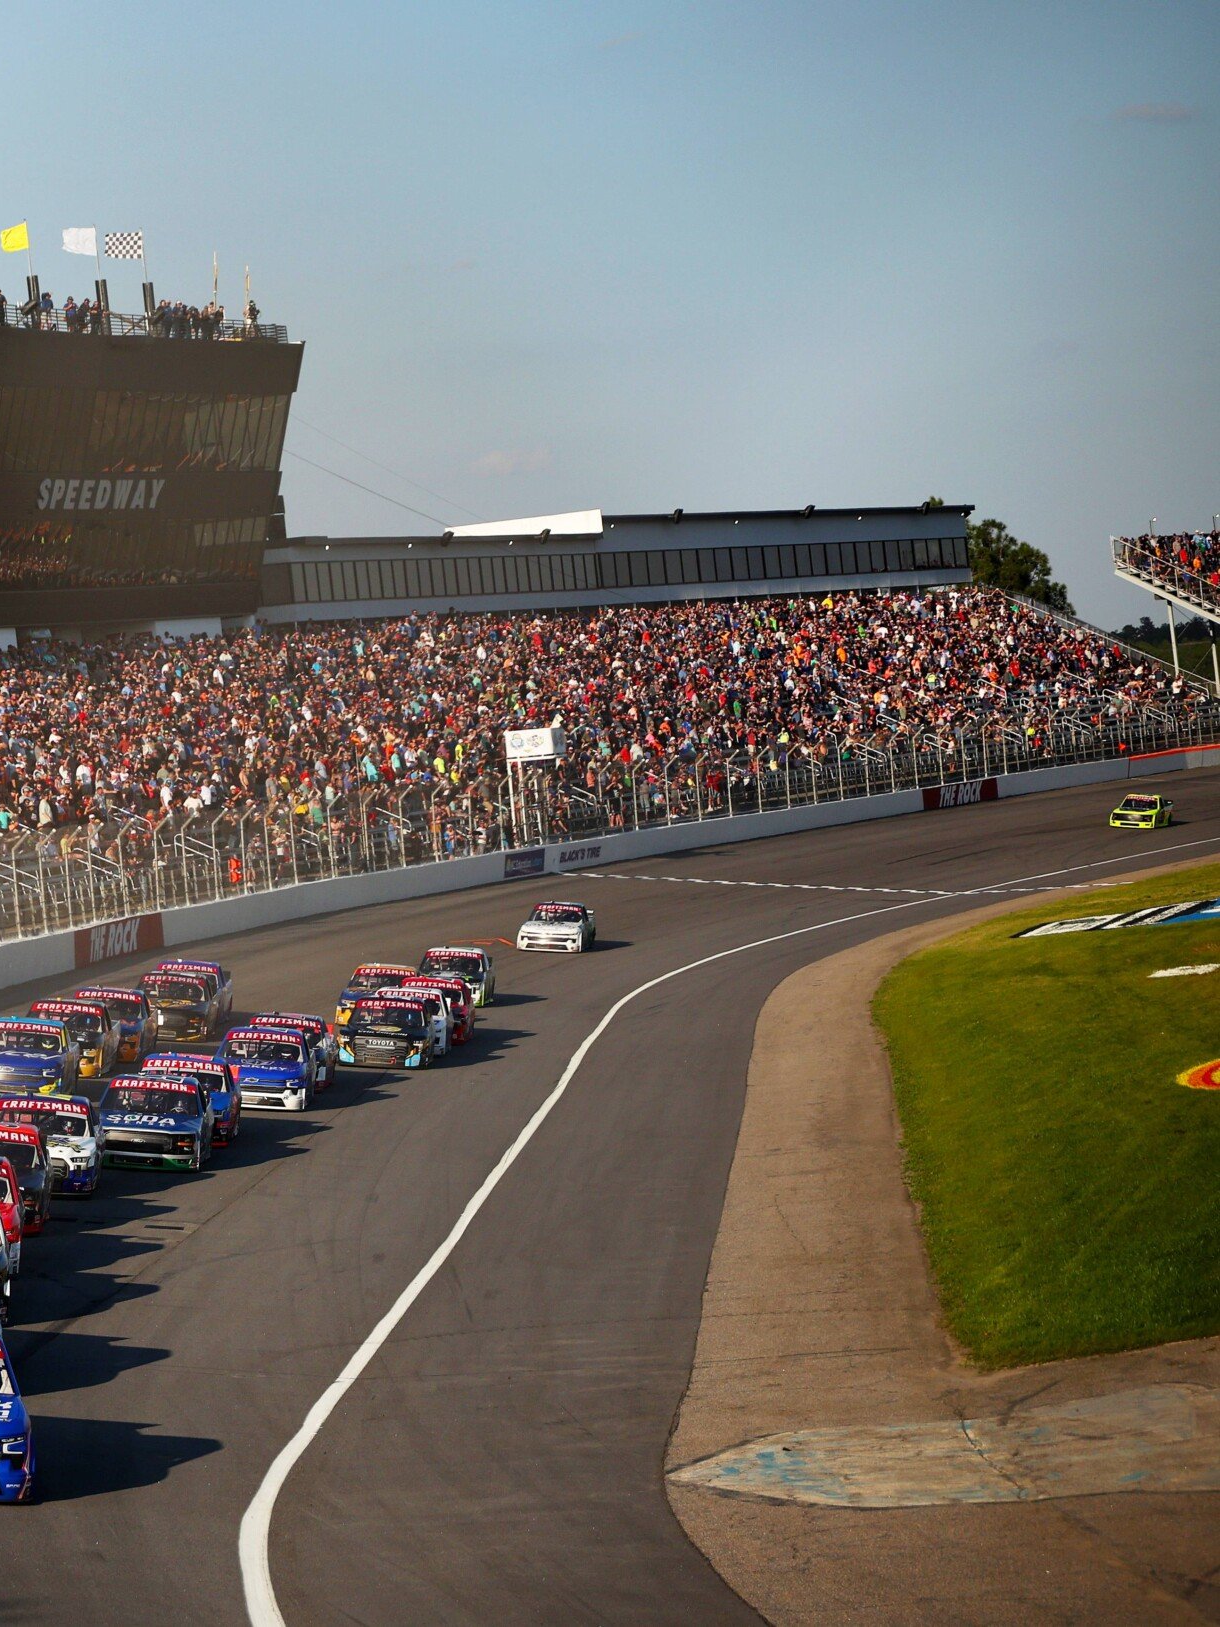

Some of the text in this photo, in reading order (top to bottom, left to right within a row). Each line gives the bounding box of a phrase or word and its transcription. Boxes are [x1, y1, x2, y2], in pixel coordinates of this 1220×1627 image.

[37, 478, 166, 510] SPEEDWAY
[939, 781, 983, 808] THE ROCK
[559, 847, 586, 864] BLACK'S
[586, 846, 602, 860] TIRE
[89, 918, 141, 963] THE ROCK
[161, 964, 214, 973] CRAFTSMAN
[359, 968, 412, 977] CRAFTSMAN
[144, 975, 200, 984] CRAFTSMAN
[405, 980, 459, 990] CRAFTSMAN
[79, 990, 137, 1001] CRAFTSMAN
[382, 990, 436, 1000] CRAFTSMAN
[37, 1002, 96, 1014] CRAFTSMAN
[362, 1000, 419, 1010] CRAFTSMAN
[256, 1016, 317, 1028] CRAFTSMAN
[232, 1031, 297, 1043] CRAFTSMAN
[147, 1059, 221, 1072] CRAFTSMAN
[115, 1079, 188, 1092] CRAFTSMAN
[2, 1100, 82, 1113] CRAFTSMAN
[106, 1114, 176, 1126] SODA
